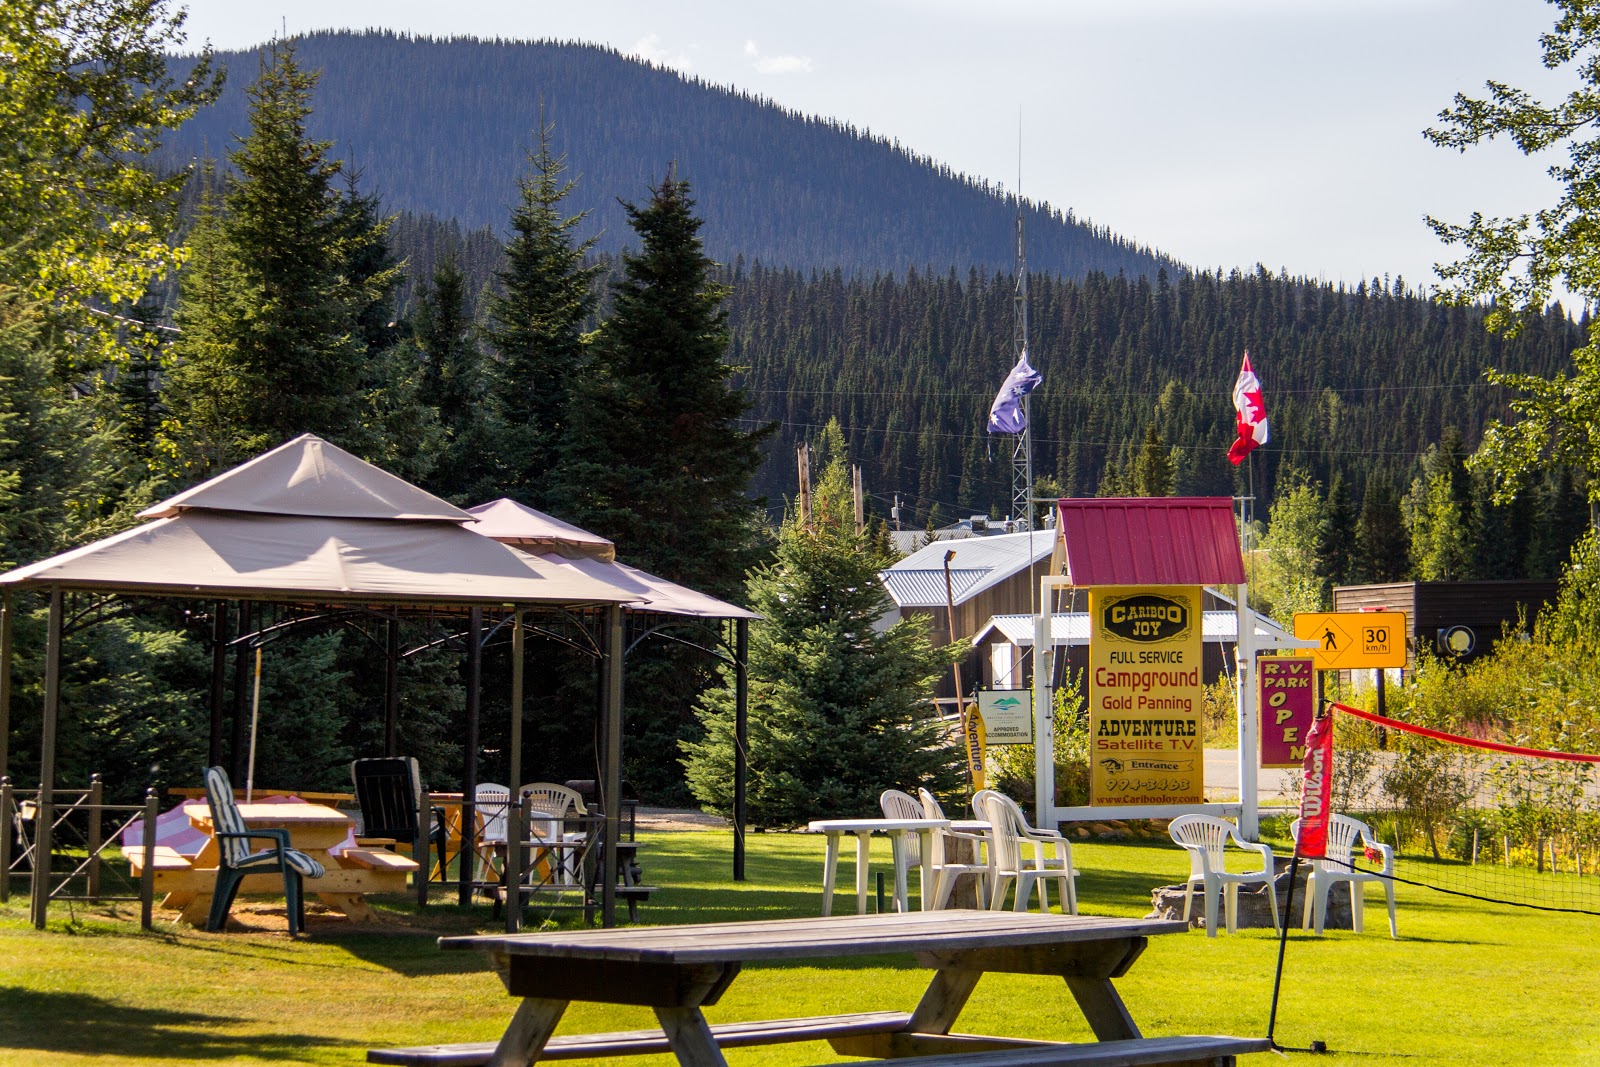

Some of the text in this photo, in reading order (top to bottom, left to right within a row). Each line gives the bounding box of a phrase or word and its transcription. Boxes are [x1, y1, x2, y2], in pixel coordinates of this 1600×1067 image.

[1112, 606, 1182, 623] CARIBOO
[1132, 621, 1161, 636] JOY
[1366, 629, 1387, 643] 30
[1366, 644, 1387, 652] km/h
[1110, 651, 1183, 664] FULL SERVICE
[1095, 666, 1198, 692] Campground
[1264, 677, 1309, 689] PARK
[1102, 695, 1192, 713] Gold Panning
[1097, 719, 1196, 737] ADVENTURE
[1097, 739, 1197, 750] Satellite T.V.
[1131, 760, 1179, 770] Entrance
[1105, 778, 1191, 791] 994-3463
[1303, 747, 1325, 818] Wilson
